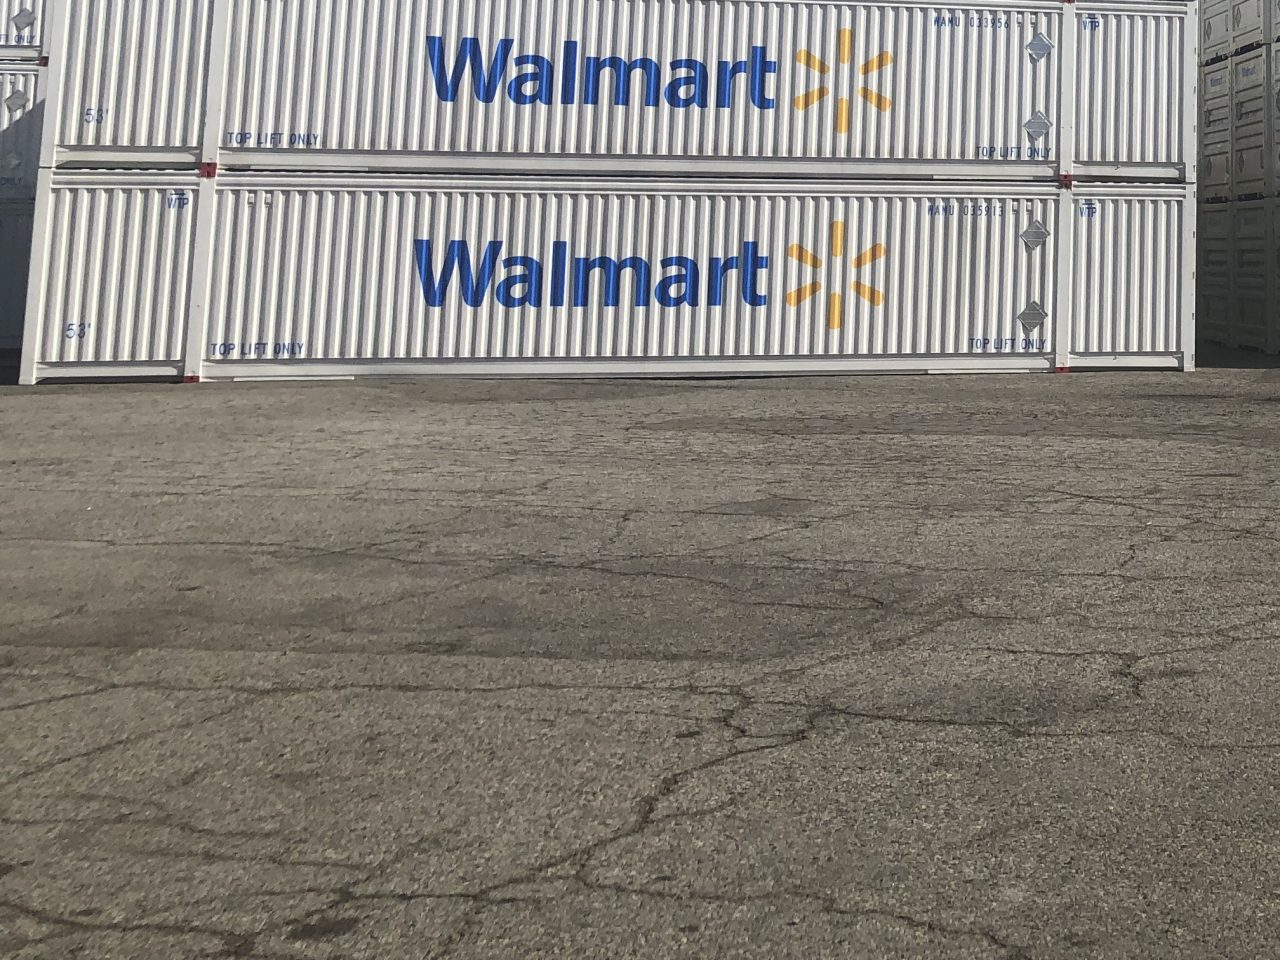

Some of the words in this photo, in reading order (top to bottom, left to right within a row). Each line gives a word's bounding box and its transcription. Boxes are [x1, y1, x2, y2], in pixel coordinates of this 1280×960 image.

[970, 17, 1009, 28] 033956
[425, 36, 777, 110] Walmart
[84, 108, 109, 123] 53'
[227, 132, 252, 144] TOP
[257, 133, 283, 145] LIFT
[289, 134, 319, 146] ONLY
[976, 147, 996, 158] TOP
[1000, 147, 1022, 159] LIFT
[1026, 148, 1052, 160] ONLY
[963, 205, 1004, 217] 035913
[414, 239, 769, 309] Walmart
[65, 323, 91, 339] 53'
[211, 344, 236, 356] TOP
[240, 343, 268, 355] LIFT
[273, 343, 304, 355] ONLY
[970, 339, 990, 350] TOP
[994, 338, 1016, 350] LIFT
[1021, 338, 1046, 350] ONLY
